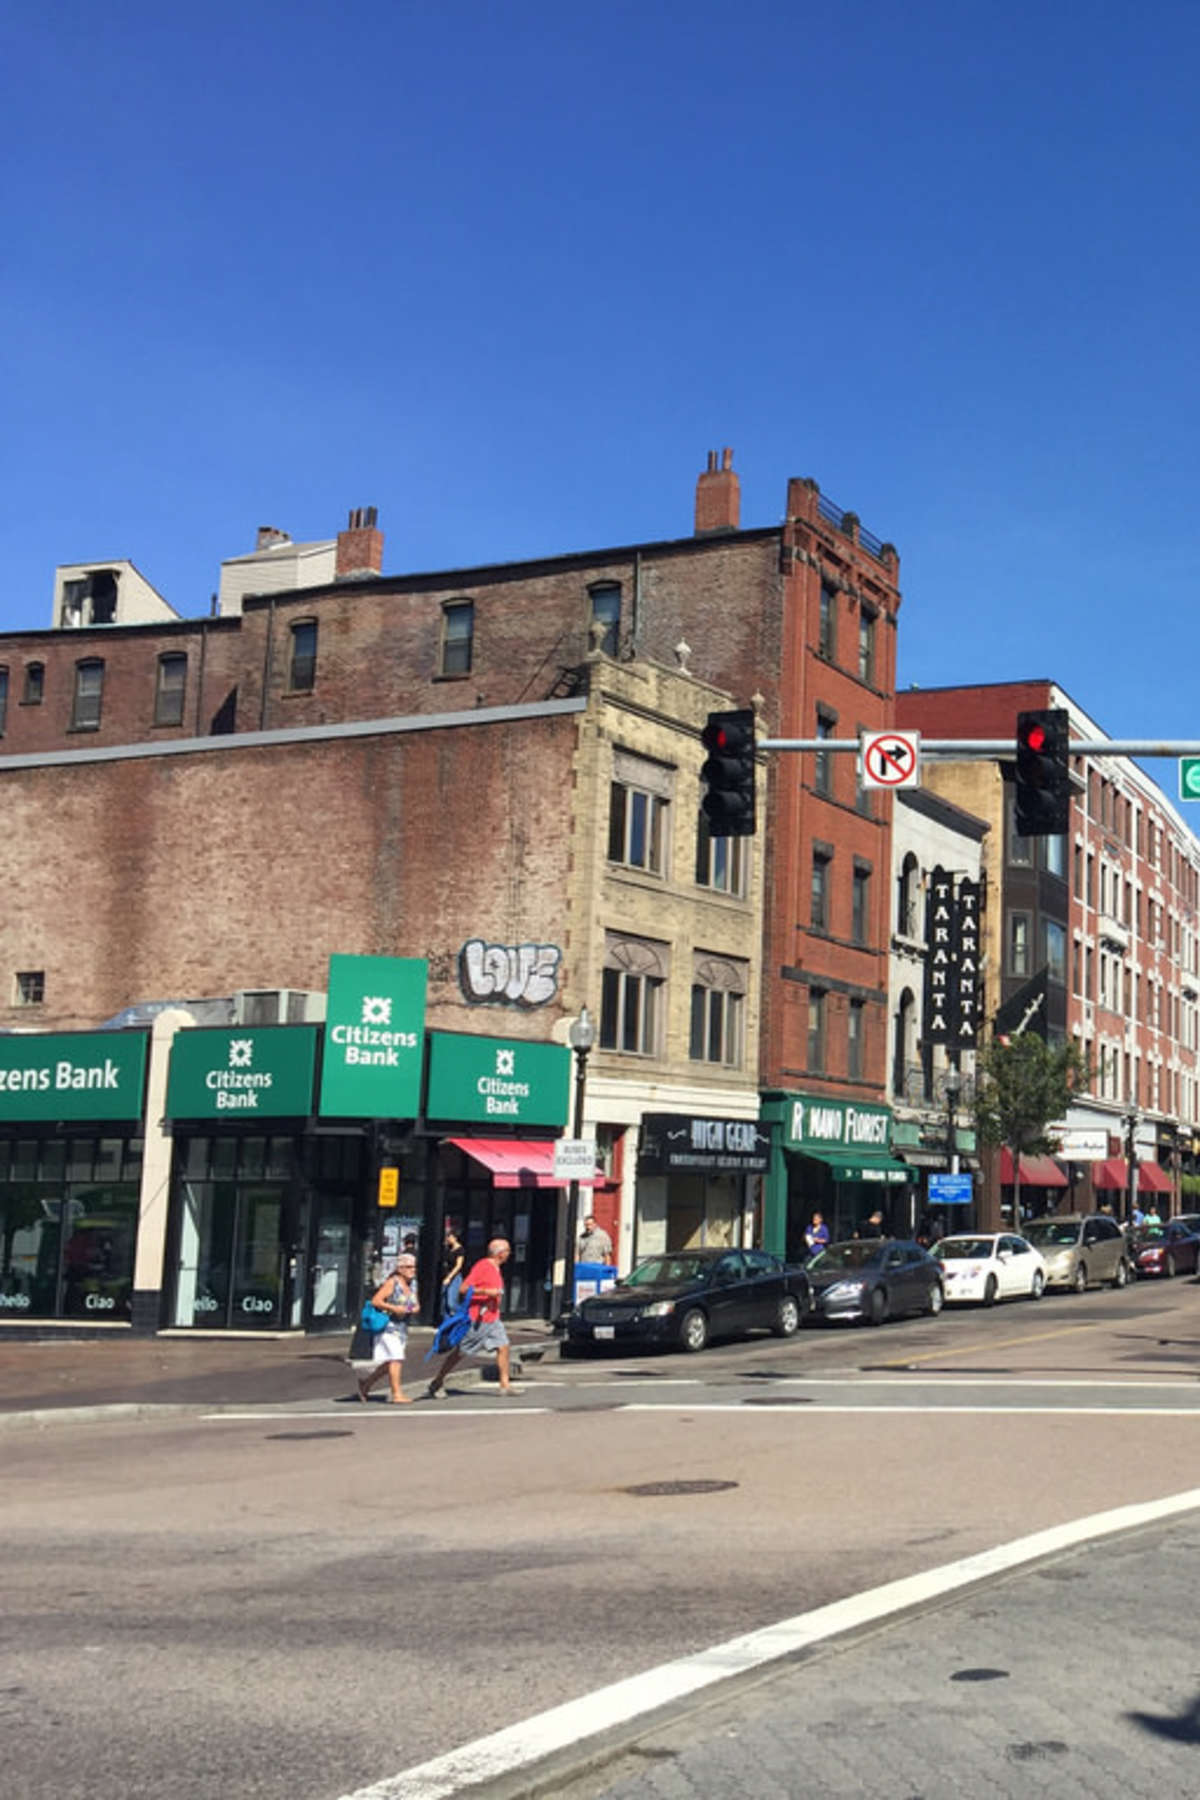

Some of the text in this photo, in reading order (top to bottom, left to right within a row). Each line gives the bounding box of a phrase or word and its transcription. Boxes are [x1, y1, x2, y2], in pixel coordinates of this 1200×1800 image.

[931, 884, 950, 1031] TARANTA
[959, 895, 976, 1036] TARANTA
[331, 1025, 417, 1047] Citizens
[345, 1046, 398, 1067] Bank
[55, 1060, 119, 1089] Bank
[206, 1069, 272, 1089] Citizens
[477, 1076, 529, 1097] Citizens
[216, 1090, 258, 1109] Bank
[486, 1097, 519, 1115] Bank
[691, 1119, 723, 1149] HIGH
[86, 1294, 115, 1310] Ciao
[242, 1296, 273, 1312] Ciao
